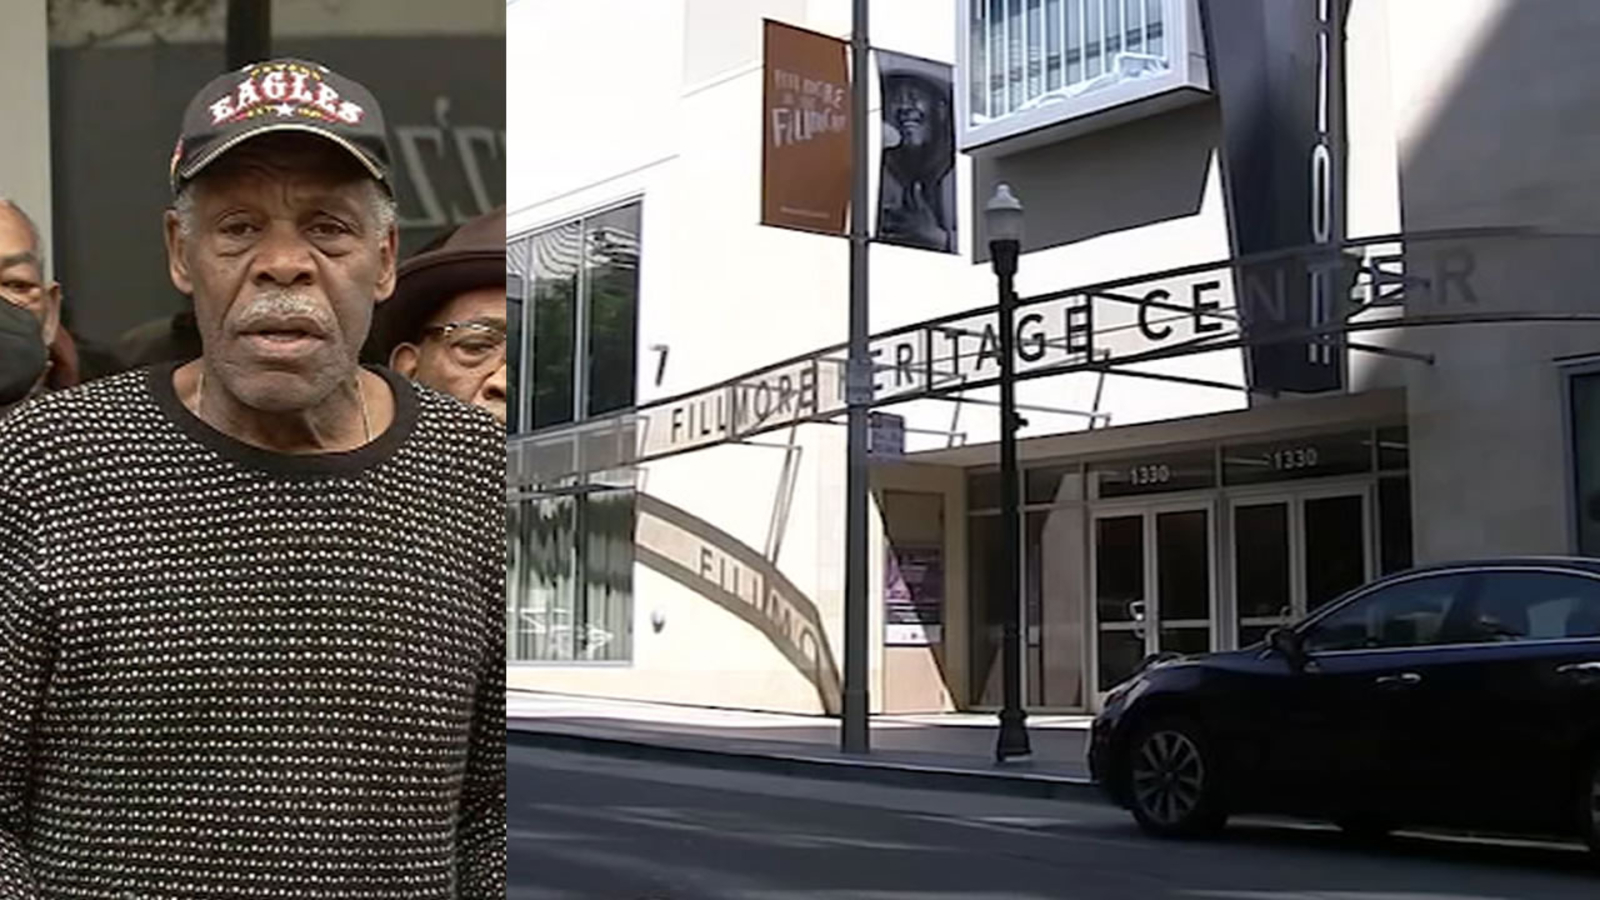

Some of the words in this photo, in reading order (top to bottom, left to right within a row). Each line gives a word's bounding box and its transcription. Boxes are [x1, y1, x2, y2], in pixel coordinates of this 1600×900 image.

[209, 70, 362, 125] EAGLES
[671, 366, 814, 444] FILLMORE
[838, 305, 1091, 402] ERITAGE
[1130, 465, 1170, 485] 1330
[1274, 448, 1318, 469] 1330
